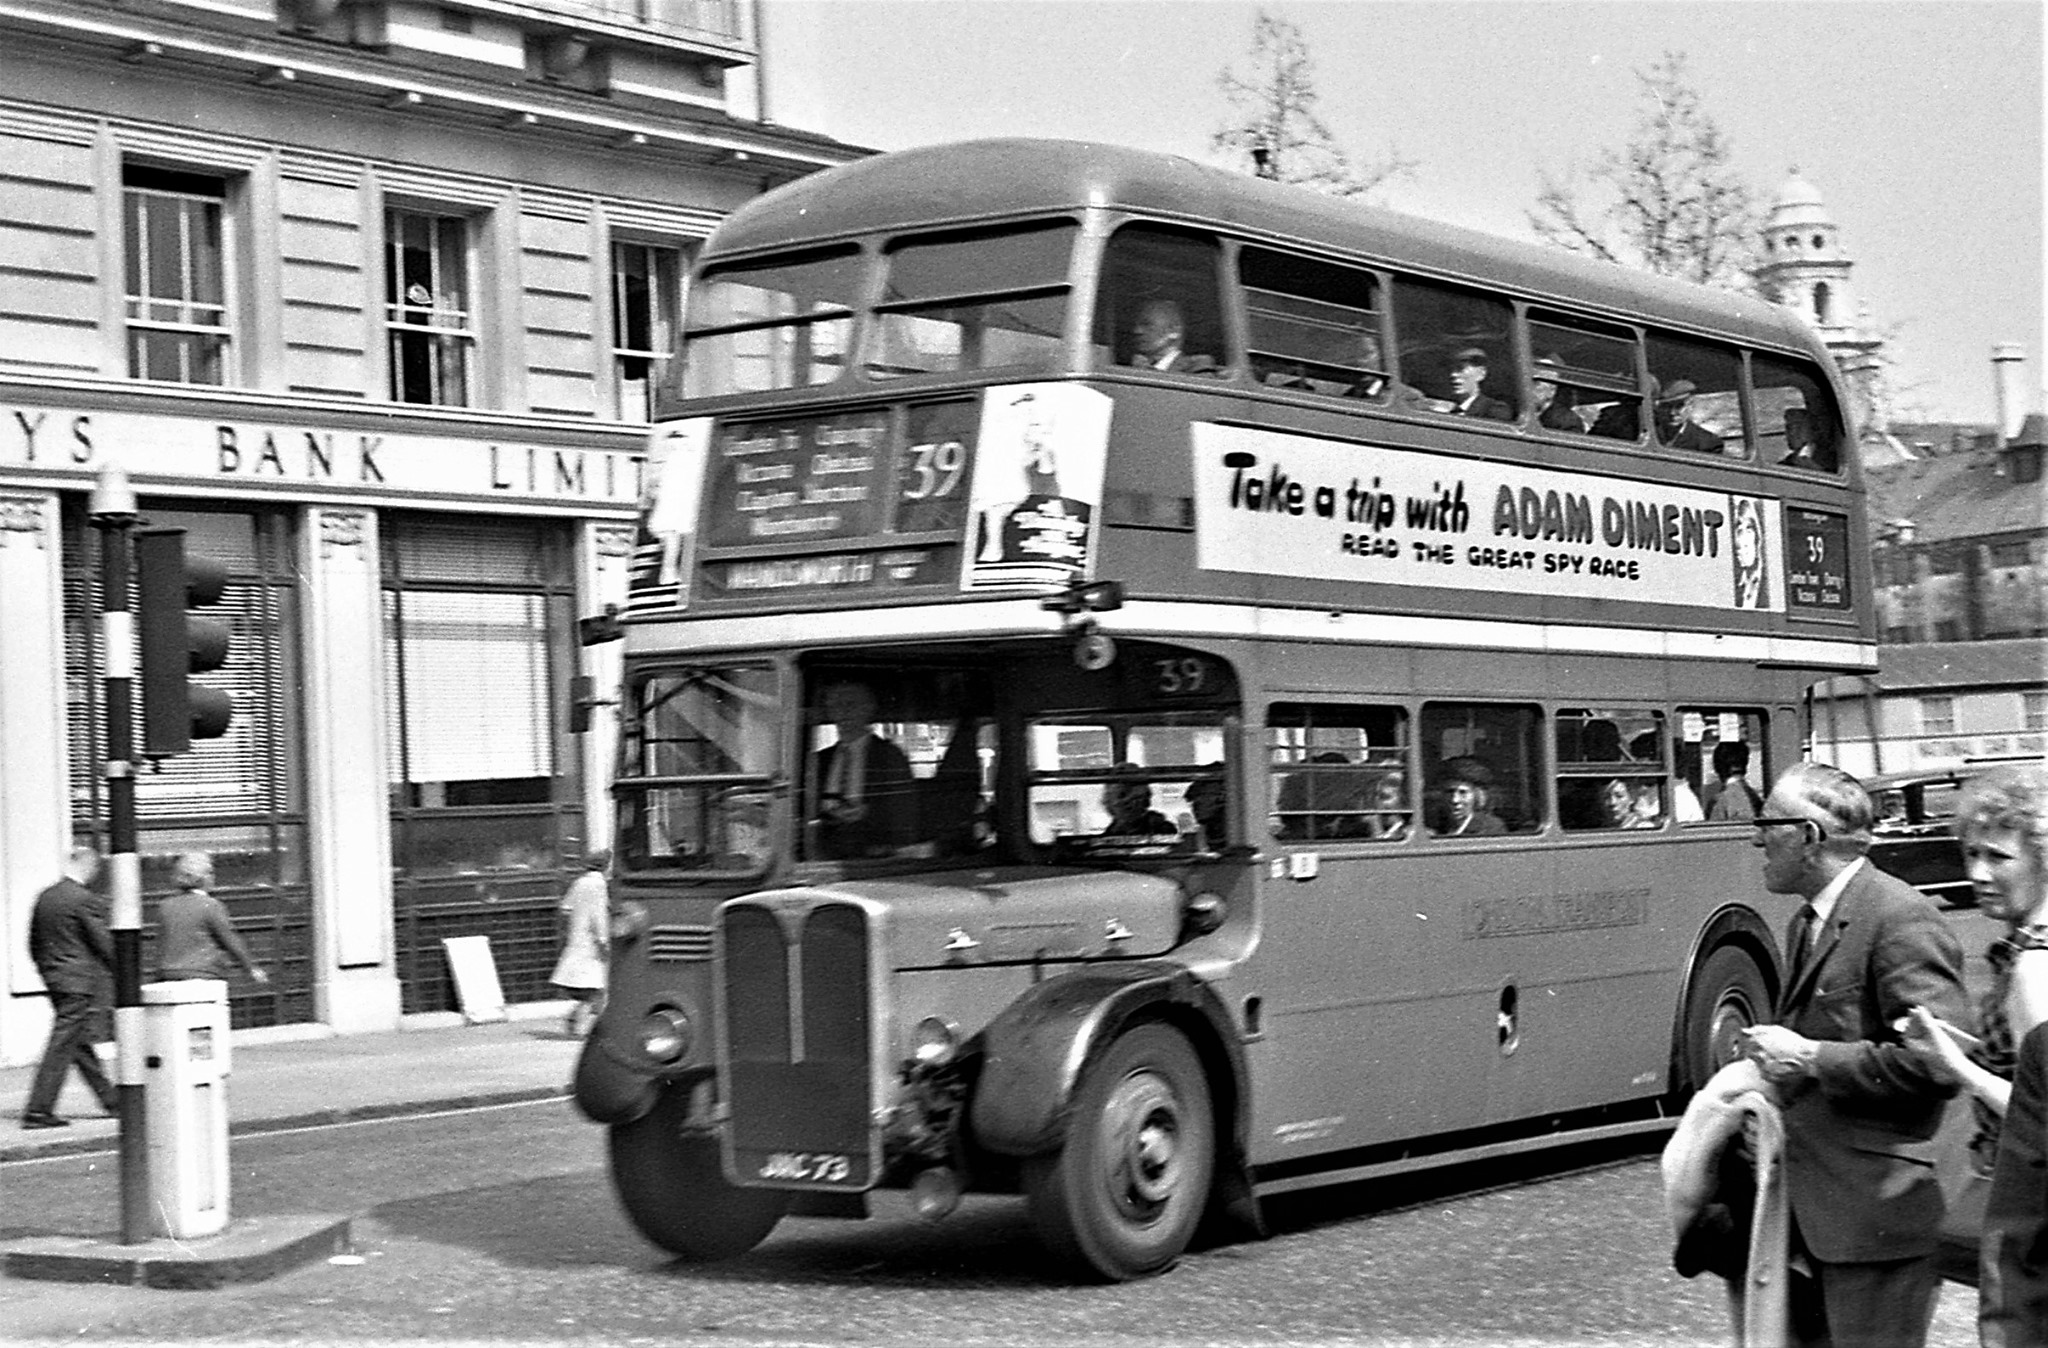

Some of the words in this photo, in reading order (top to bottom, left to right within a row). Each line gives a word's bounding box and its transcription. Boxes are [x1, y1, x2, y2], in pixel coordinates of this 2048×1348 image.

[13, 410, 94, 465] YS
[216, 425, 386, 484] BANK
[487, 445, 649, 498] LIMIT
[902, 442, 967, 500] 39
[1223, 451, 1304, 516] Take
[1315, 486, 1336, 519] a
[1346, 476, 1396, 533] trip
[1406, 480, 1470, 533] with
[1493, 484, 1594, 545] ADAM
[1602, 497, 1724, 558] DIMENT
[1342, 533, 1399, 558] READ
[1412, 541, 1454, 566] THE
[1467, 545, 1536, 570] GREAT
[1543, 552, 1583, 574] SPY
[1589, 556, 1640, 581] RACE
[1806, 535, 1825, 564] 39
[1153, 656, 1202, 692] 39
